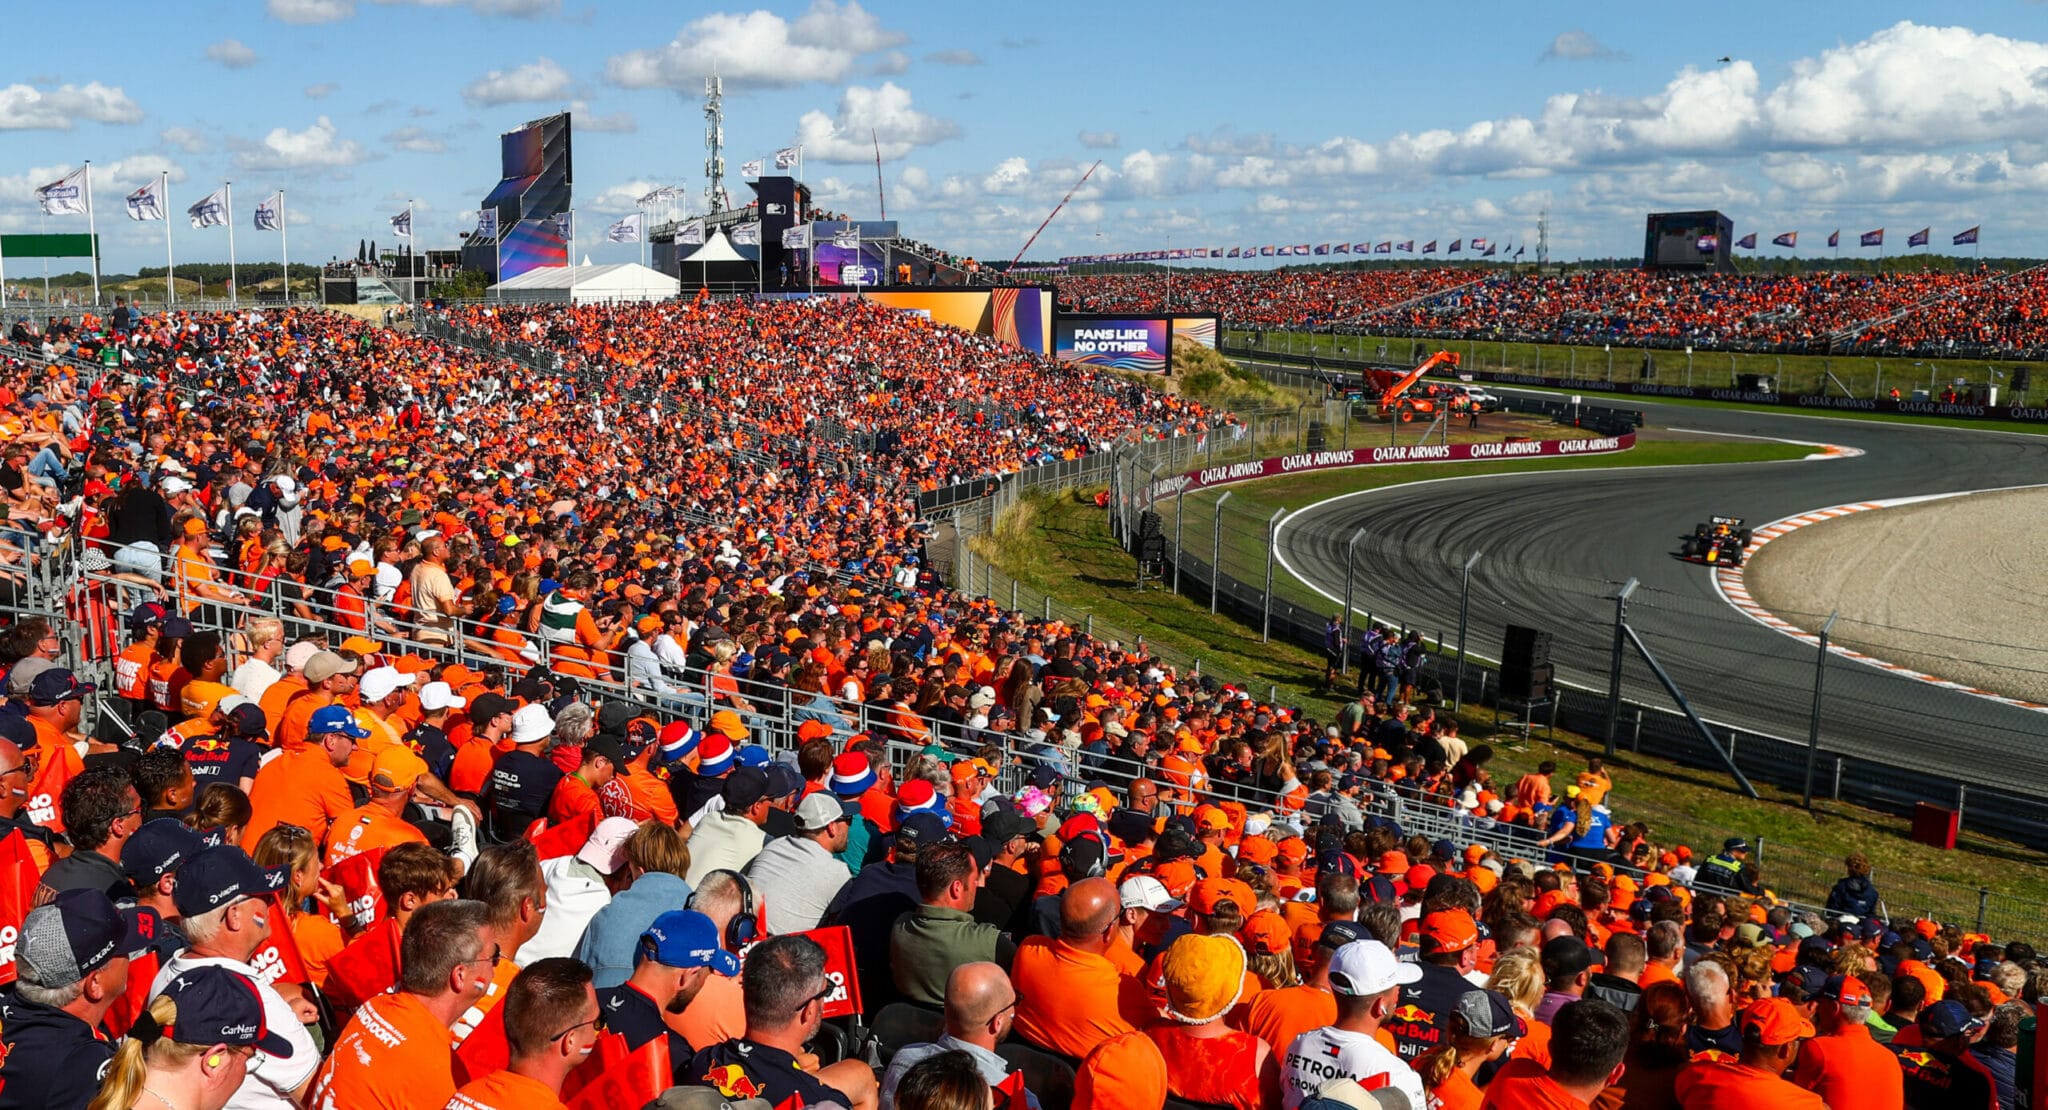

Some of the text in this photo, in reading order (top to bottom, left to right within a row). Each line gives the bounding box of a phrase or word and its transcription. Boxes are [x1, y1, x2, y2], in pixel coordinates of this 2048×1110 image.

[1074, 329, 1148, 340] FANS LIKE
[1074, 341, 1148, 352] NO OTHER
[1799, 395, 1876, 410] QATAR AIRWAYS
[1898, 401, 1985, 416] QATAR AIRWAYS
[1373, 445, 1450, 461] QATAR AIRWAYS
[1470, 441, 1542, 458] QATAR AIRWAYS
[1558, 437, 1619, 453] QATAR AIRWAYS
[1282, 450, 1354, 470] QATAR AIRWAYS
[1200, 460, 1264, 485] QATAR AIRWAYS
[185, 750, 230, 762] Red Bull
[191, 766, 209, 776] obil
[89, 940, 115, 965] exact
[221, 1024, 257, 1035] CarNext
[1408, 1024, 1439, 1043] Bull
[1399, 1041, 1417, 1056] bil
[1286, 1053, 1357, 1081] PETRONA
[1290, 1077, 1319, 1096] CROW
